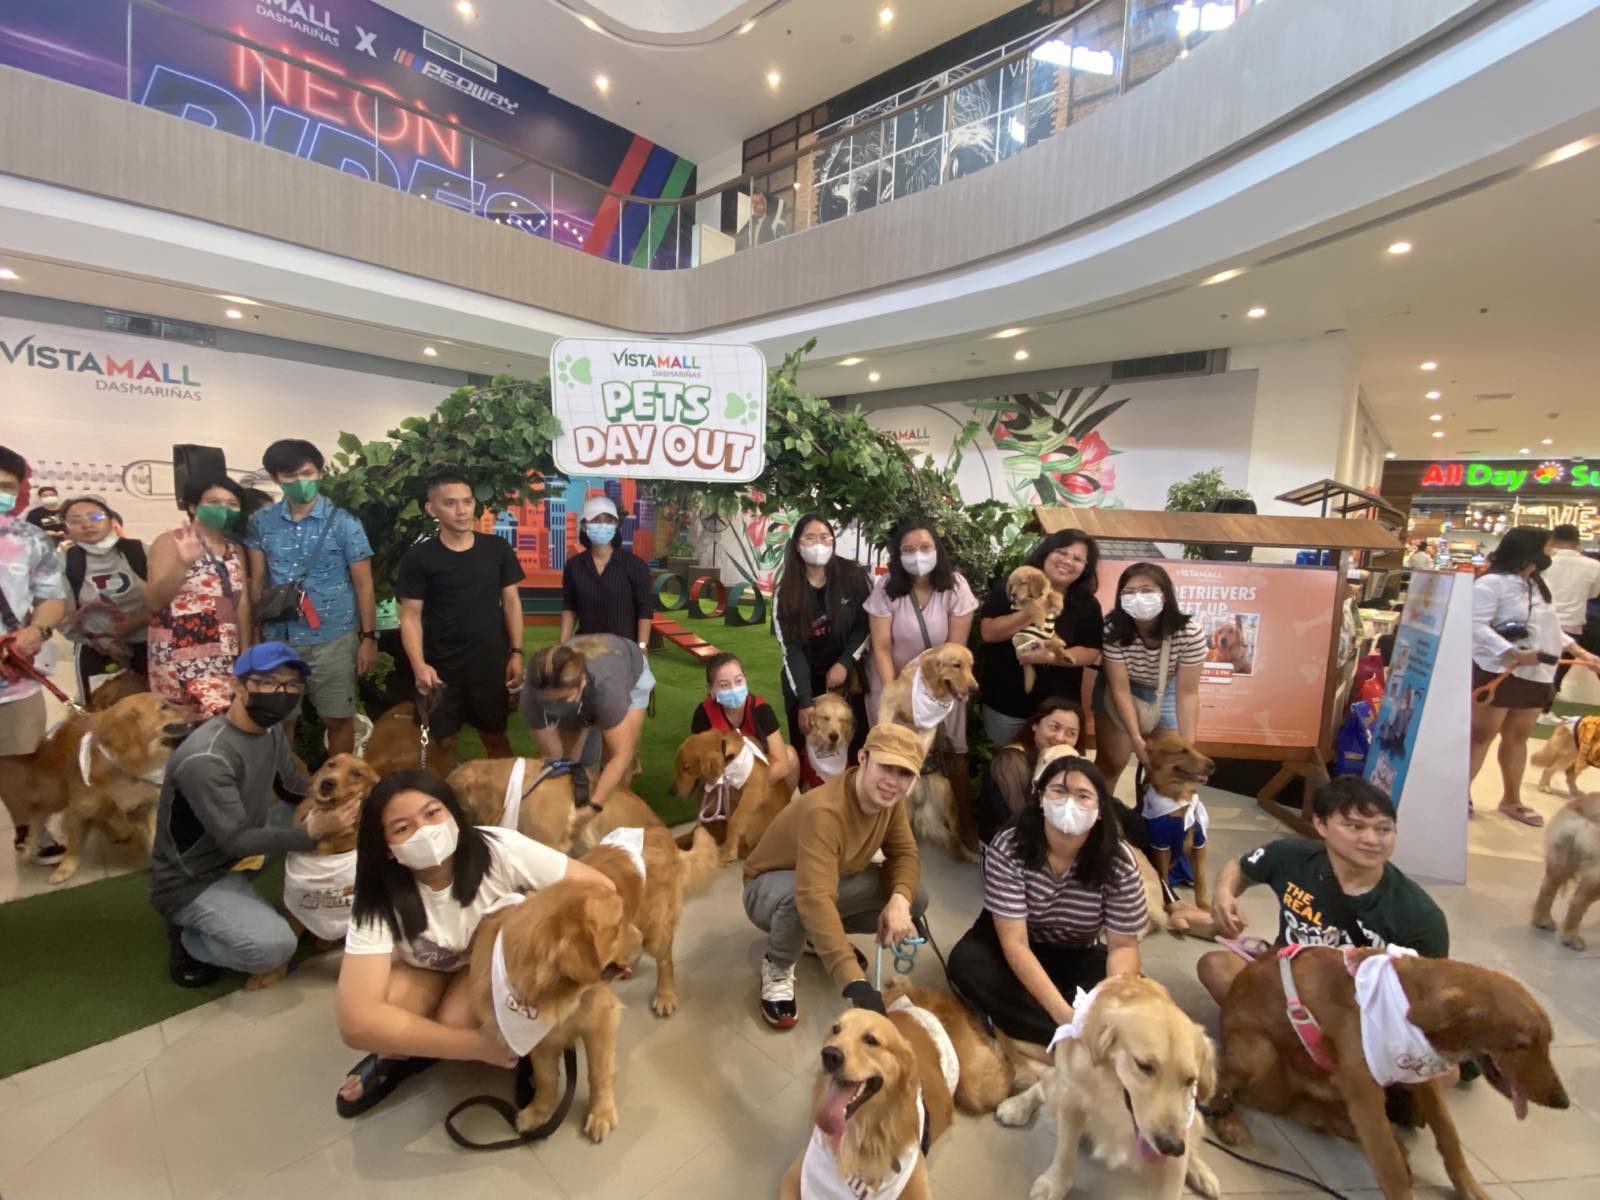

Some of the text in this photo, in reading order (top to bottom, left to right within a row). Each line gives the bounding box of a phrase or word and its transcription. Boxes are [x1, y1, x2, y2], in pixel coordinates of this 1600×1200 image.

[256, 3, 340, 48] DASMARIÑAS
[236, 26, 460, 167] NEON
[0, 335, 202, 387] VISTAMALL
[613, 347, 702, 370] VISTAMALL
[95, 379, 202, 402] DASMARIÑAS
[602, 380, 711, 425] PETS
[574, 424, 756, 473] DAY OUT
[1207, 601, 1227, 617] UP
[1283, 892, 1322, 926] REAL
[1286, 881, 1315, 905] THE
